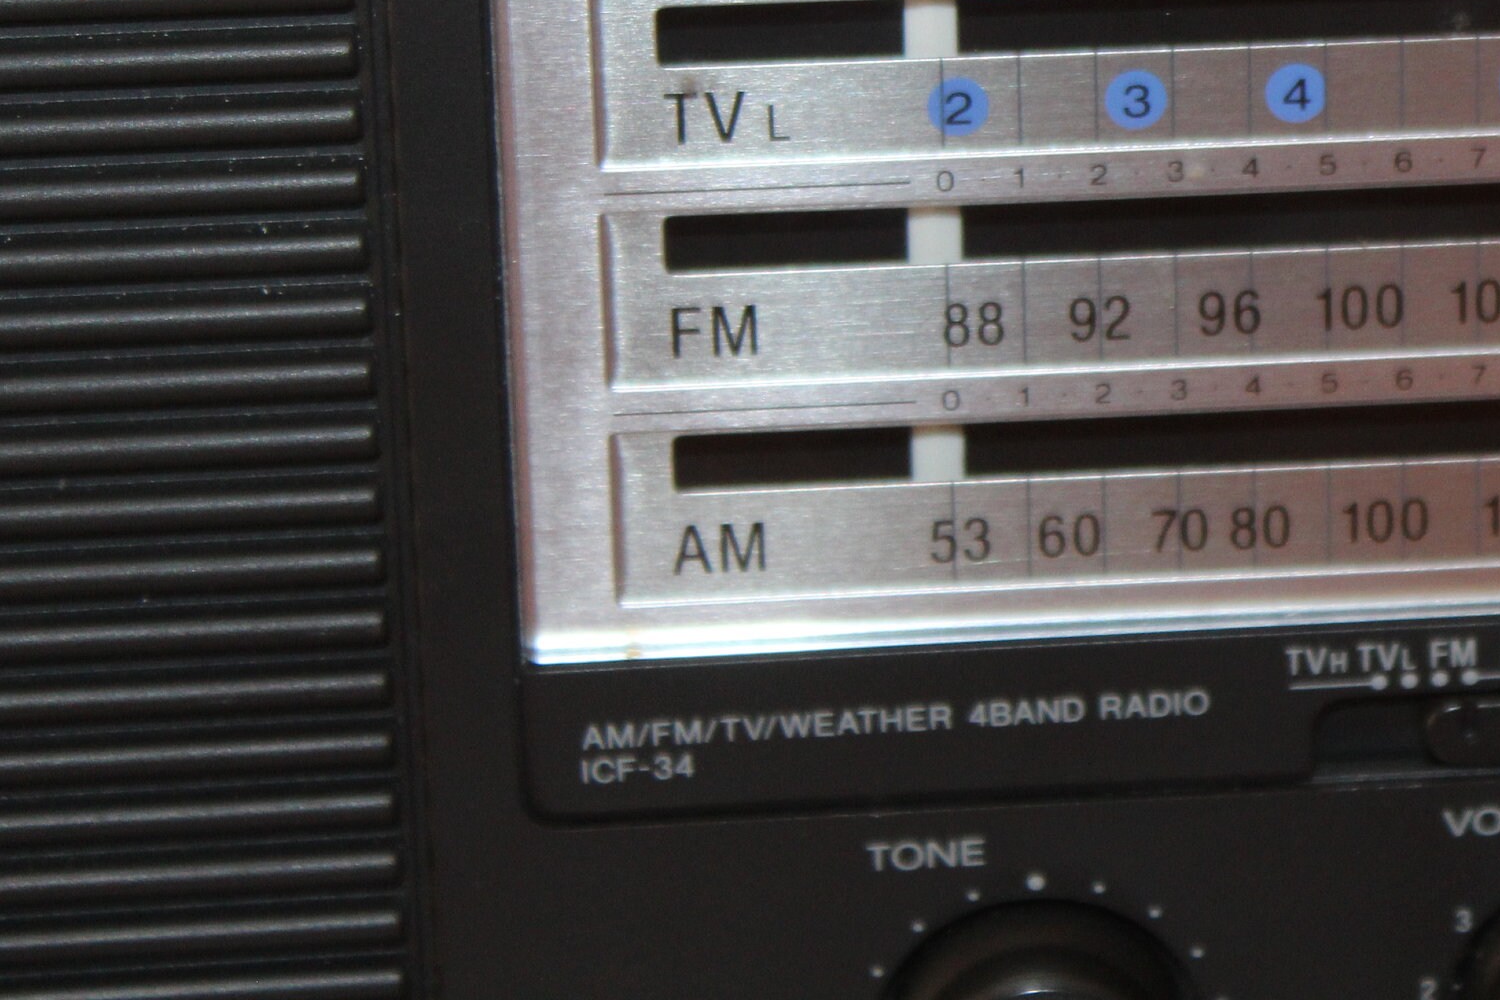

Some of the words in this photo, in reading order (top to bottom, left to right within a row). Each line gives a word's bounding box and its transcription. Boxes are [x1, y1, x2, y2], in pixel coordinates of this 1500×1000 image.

[664, 90, 745, 145] TV
[943, 92, 973, 125] 2
[1123, 84, 1151, 119] 3
[1283, 78, 1310, 111] 4
[936, 170, 954, 192] 0
[1014, 168, 1025, 188] 1
[1089, 164, 1108, 185] 2
[1167, 160, 1185, 182] 3
[1242, 158, 1260, 179] 4
[1319, 154, 1337, 176] 5
[1394, 152, 1413, 173] 6
[1472, 147, 1487, 167] 7
[670, 304, 758, 358] FM
[943, 301, 1004, 347] 88
[1069, 296, 1131, 341] 92
[1200, 290, 1261, 336] 96
[1316, 283, 1405, 331] 100
[942, 390, 960, 411] 0
[1020, 387, 1029, 406] 1
[1094, 383, 1111, 404] 2
[1171, 379, 1187, 400] 3
[1246, 376, 1261, 396] 4
[1322, 373, 1338, 393] 5
[1396, 370, 1413, 390] 6
[1472, 365, 1487, 384] 7
[674, 521, 766, 574] AM
[930, 517, 992, 563] 53
[1038, 512, 1101, 558] 60
[1151, 509, 1207, 552] 70
[1230, 505, 1290, 549] 80
[1343, 498, 1429, 544] 100
[1428, 638, 1478, 669] FM
[582, 703, 954, 751] AM/FM/TV/WEATHER
[969, 695, 1086, 729] 4BAND
[1098, 688, 1211, 721] RADIO
[580, 752, 695, 784] ICF-34
[866, 836, 987, 873] TONE
[1454, 906, 1473, 933] 3
